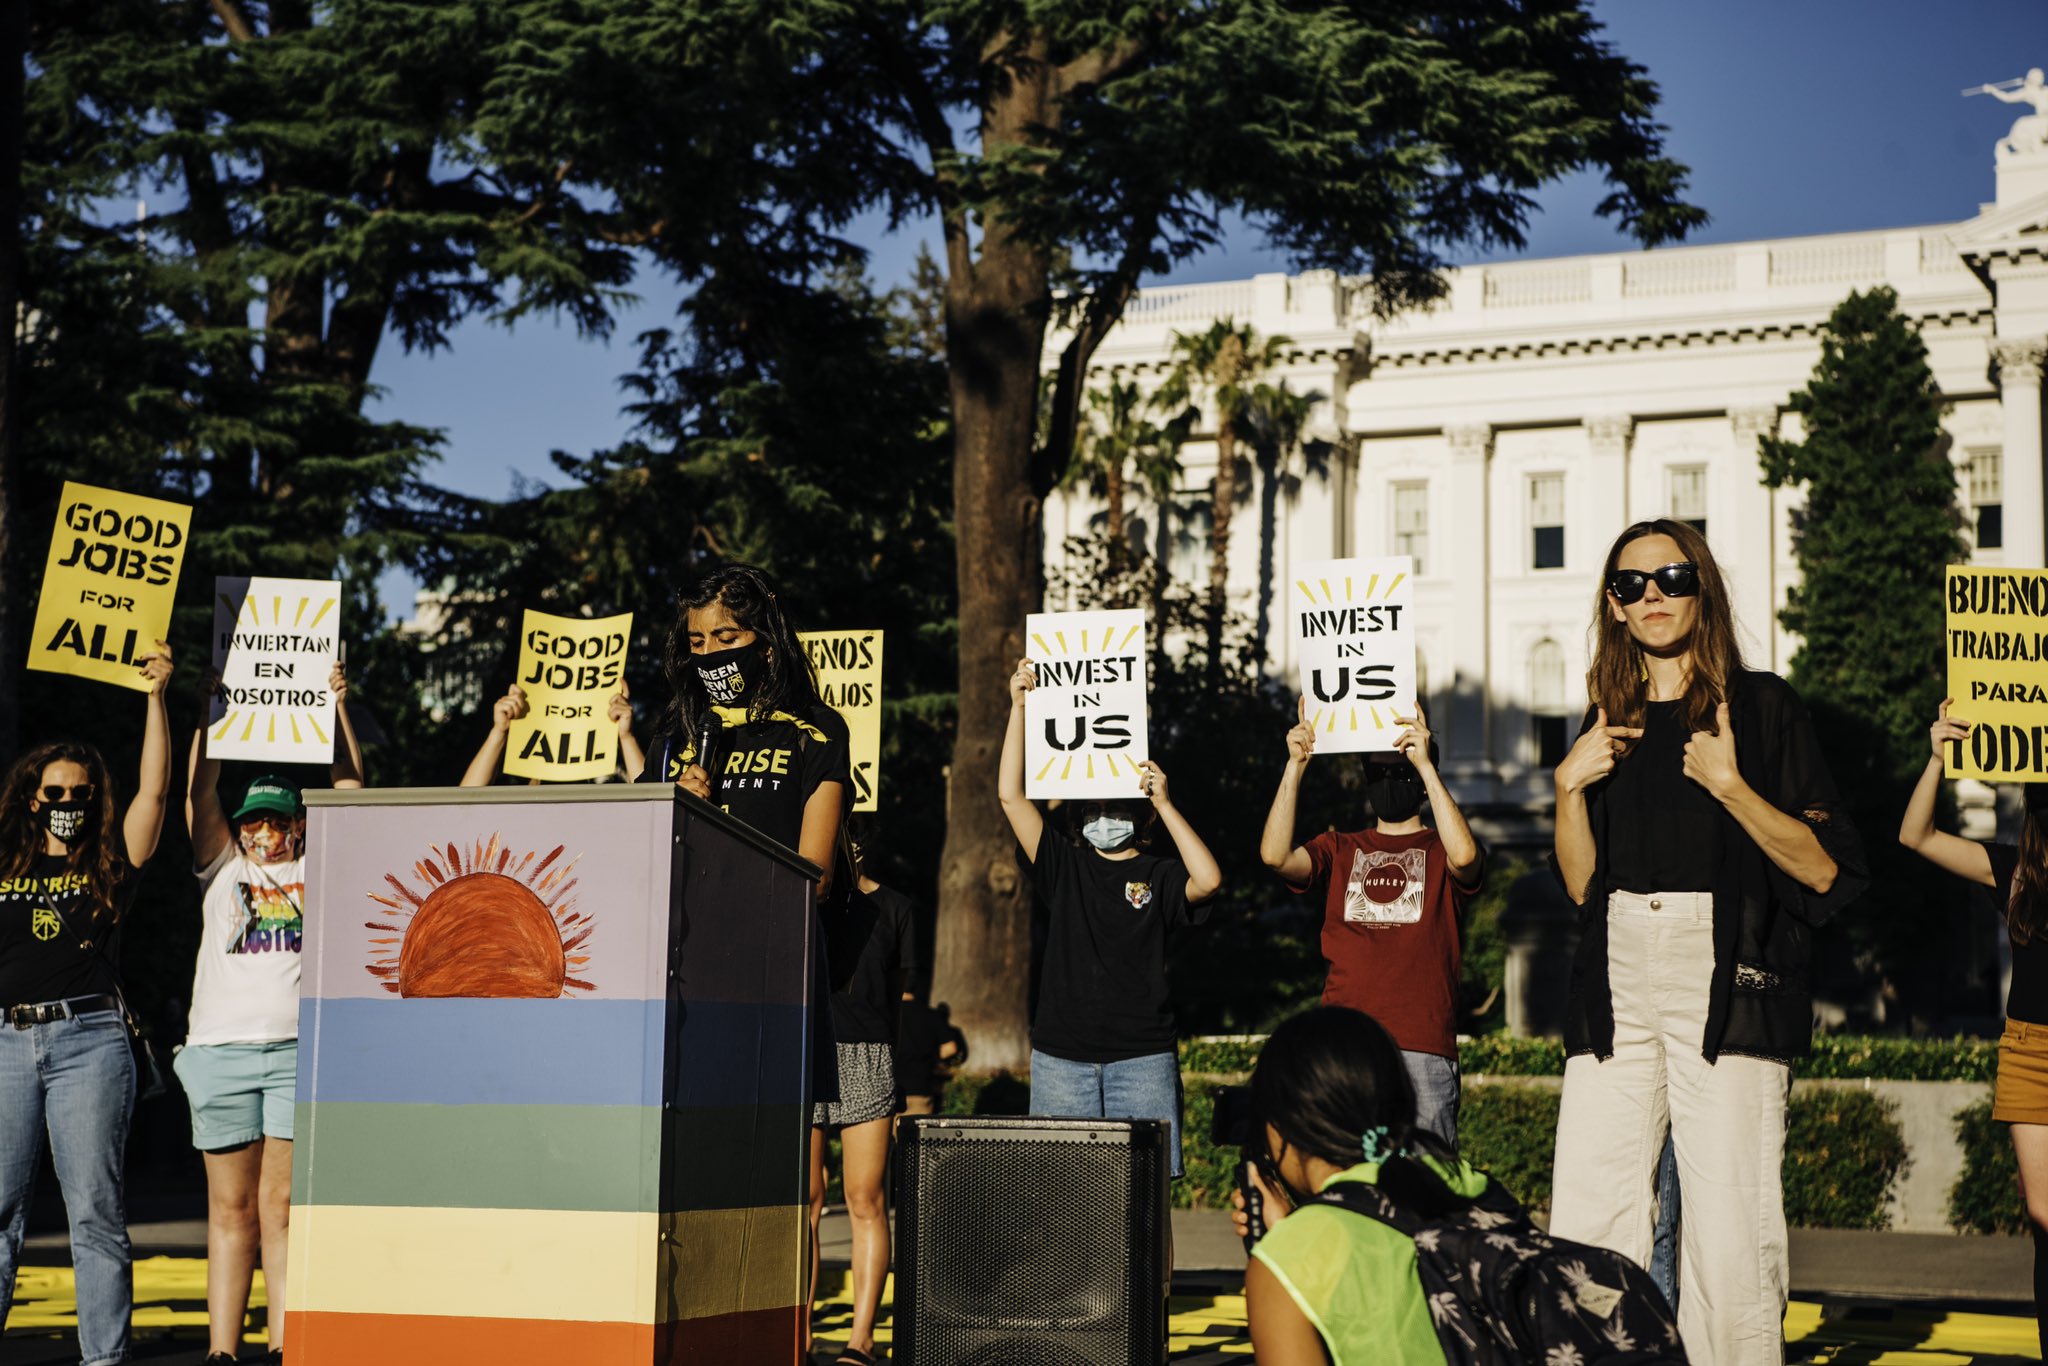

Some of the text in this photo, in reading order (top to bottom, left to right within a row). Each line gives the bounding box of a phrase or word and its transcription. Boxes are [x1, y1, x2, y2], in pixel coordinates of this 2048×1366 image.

[66, 502, 182, 548] GOOD
[58, 537, 175, 586] JOBS
[80, 590, 135, 612] FOR
[1301, 605, 1403, 638] INVEST
[46, 617, 150, 668] ALL
[221, 633, 330, 653] INVIERTAN
[528, 630, 624, 660] GOOD
[801, 636, 874, 670] ENOS
[1337, 642, 1364, 658] IN
[254, 663, 294, 678] EN
[525, 660, 620, 691] JOBS
[697, 661, 739, 680] GREEN
[1035, 656, 1136, 687] INVEST
[1312, 665, 1396, 703] US
[1971, 681, 2048, 703] PARA
[218, 688, 327, 707] NOSOTROS
[1074, 692, 1100, 708] IN
[545, 705, 592, 718] FOR
[1045, 715, 1132, 751] US
[519, 729, 605, 764] ALL
[50, 809, 84, 820] GREEN
[50, 818, 74, 829] NEW
[50, 826, 76, 837] DEAL
[1365, 878, 1405, 887] HURLEY
[0, 887, 90, 903] MOVEMEN
